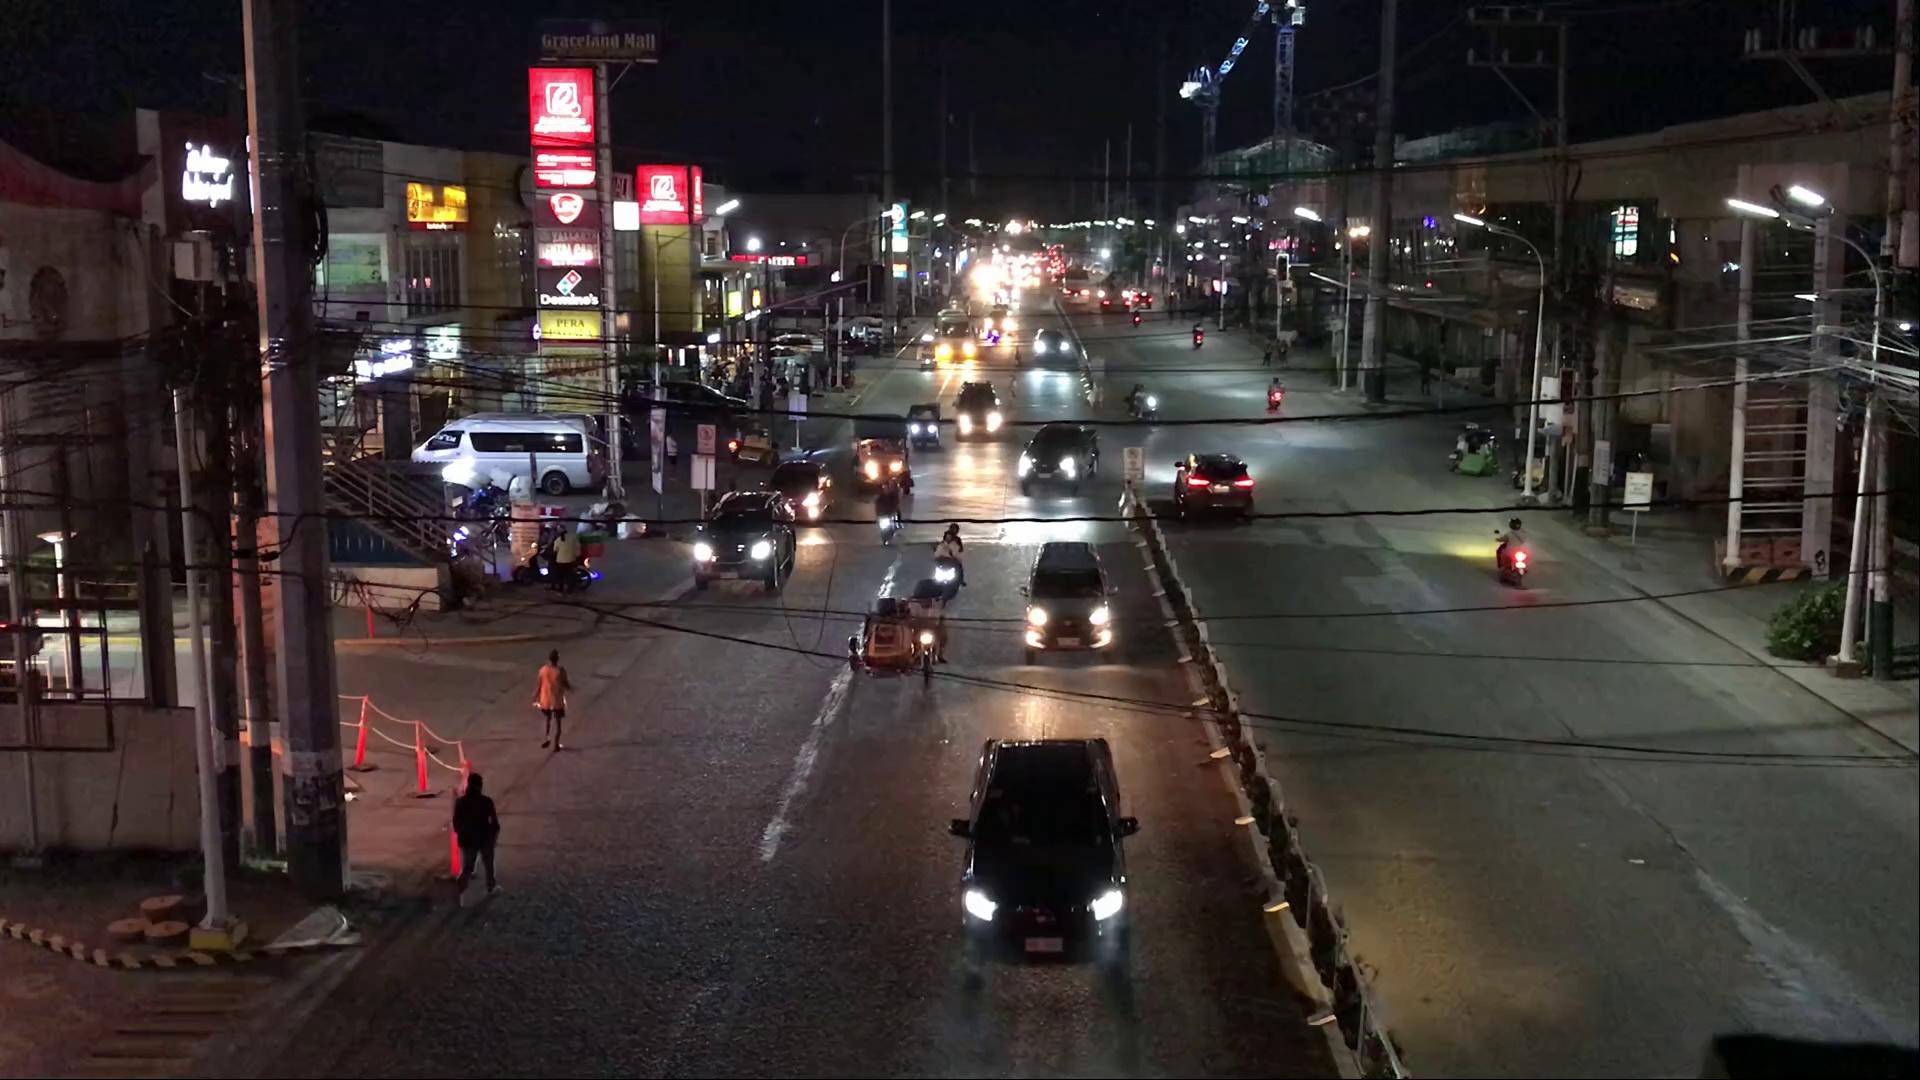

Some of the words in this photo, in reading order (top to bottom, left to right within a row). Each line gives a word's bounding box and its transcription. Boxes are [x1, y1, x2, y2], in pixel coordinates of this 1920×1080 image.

[542, 34, 619, 48] Graceland
[624, 33, 656, 49] Mall
[540, 292, 599, 305] Domino's
